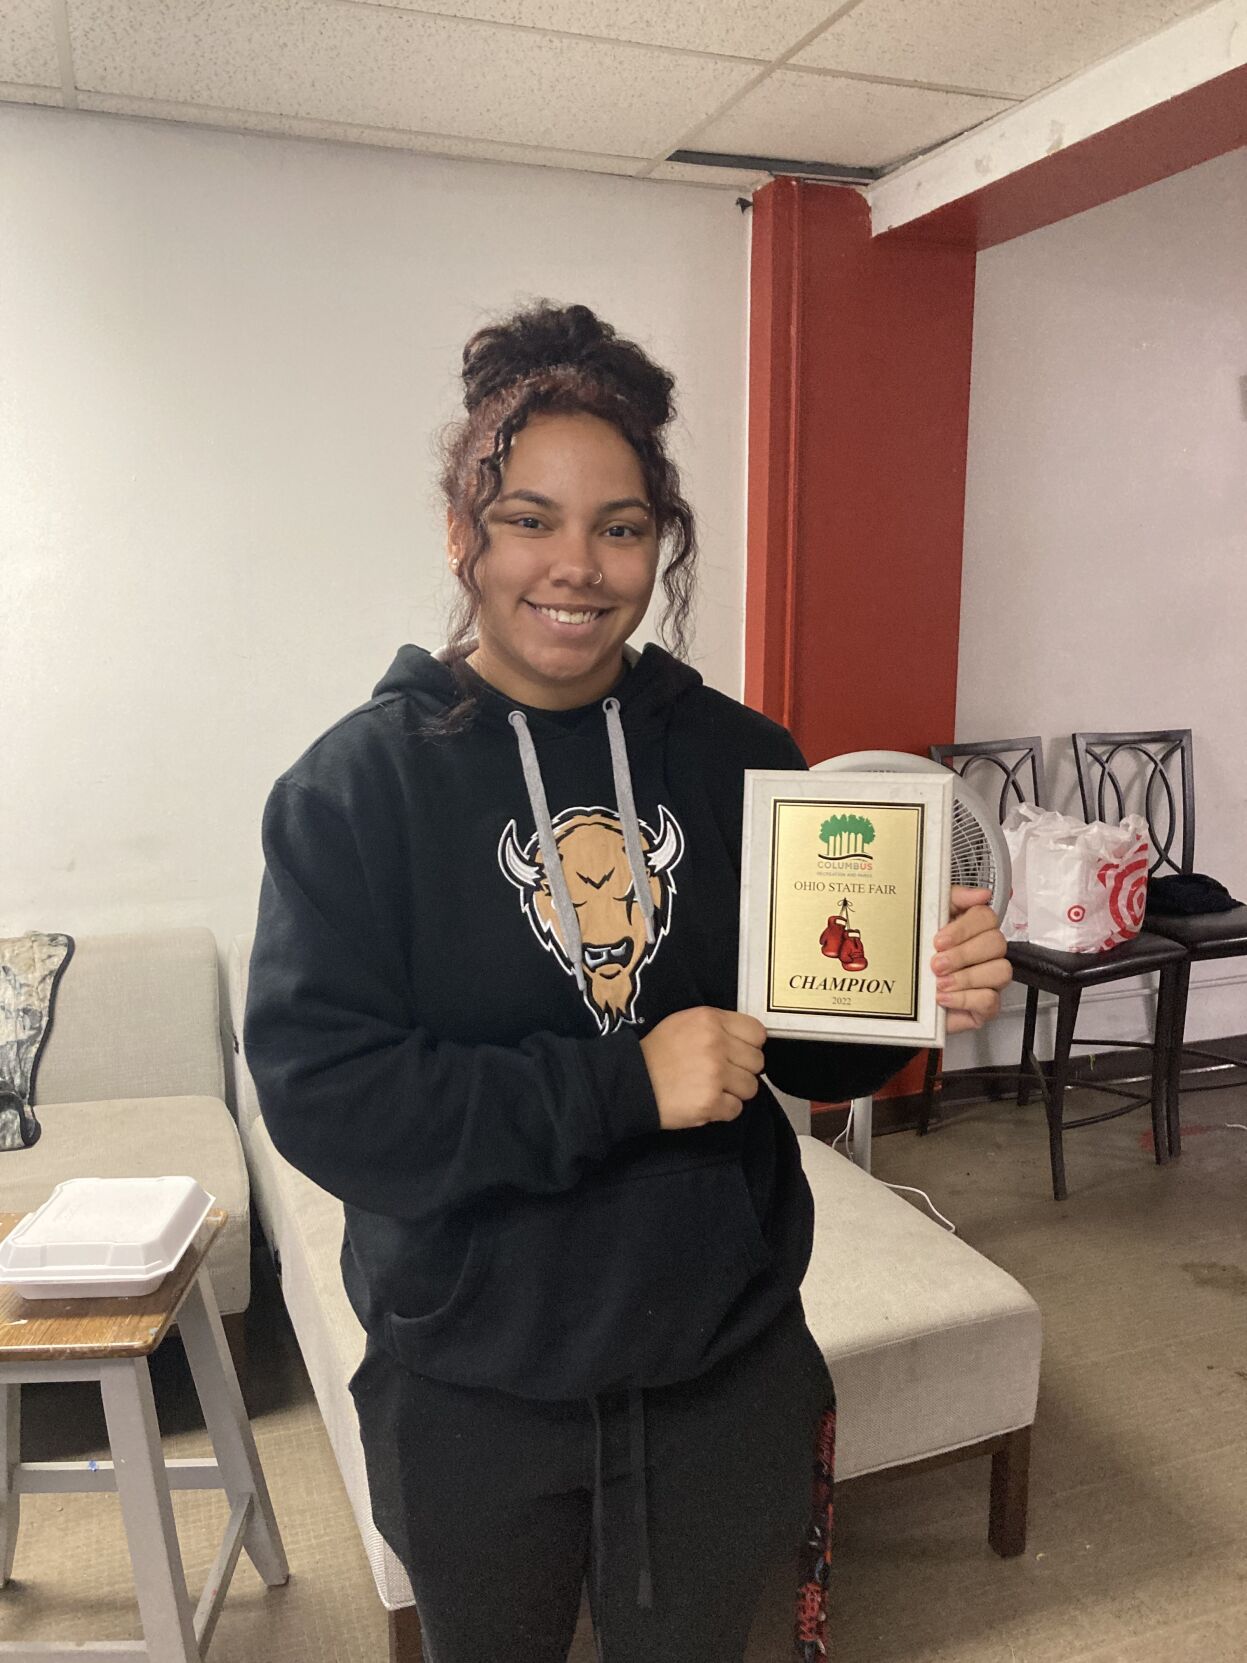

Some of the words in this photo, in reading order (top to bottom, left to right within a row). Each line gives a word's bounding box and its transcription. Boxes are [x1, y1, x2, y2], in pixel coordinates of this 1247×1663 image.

[817, 861, 873, 871] COLUMBUS
[794, 881, 826, 891] OHIO
[828, 882, 865, 894] STATE
[868, 884, 897, 895] FAIR
[789, 974, 896, 994] CHAMPION
[832, 996, 852, 1006] 2022
